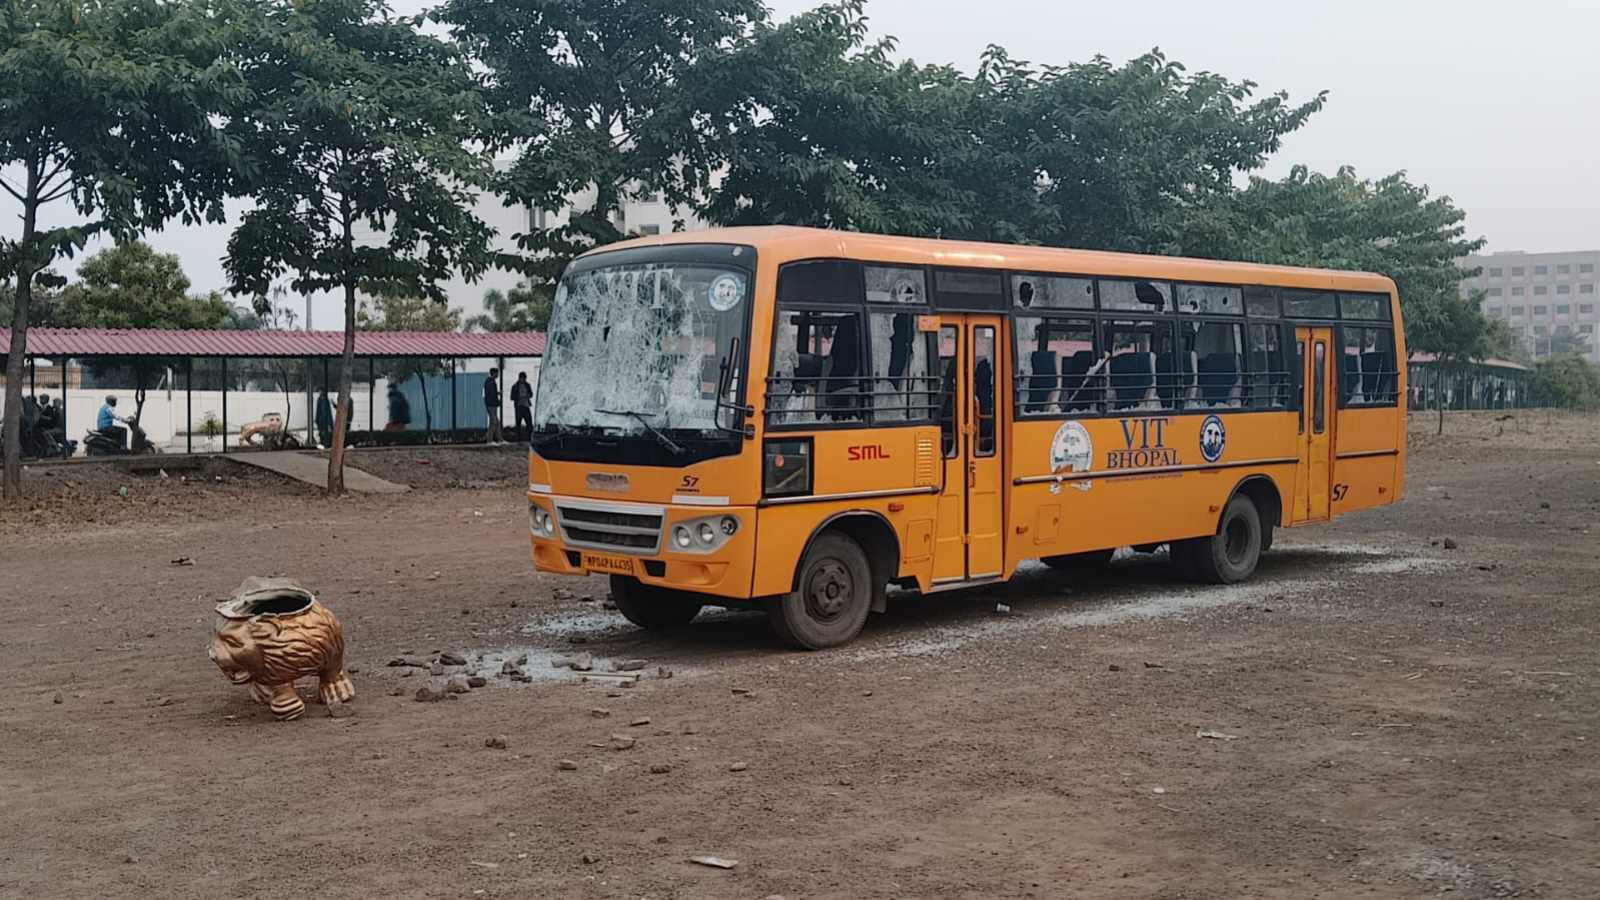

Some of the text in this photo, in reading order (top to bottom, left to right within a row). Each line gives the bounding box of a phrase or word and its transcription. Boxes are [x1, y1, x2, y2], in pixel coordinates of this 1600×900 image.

[1119, 418, 1169, 448] VIT
[848, 445, 890, 461] SML
[1107, 450, 1182, 468] BHOPAL
[682, 475, 699, 487] S7
[1332, 484, 1349, 501] S7
